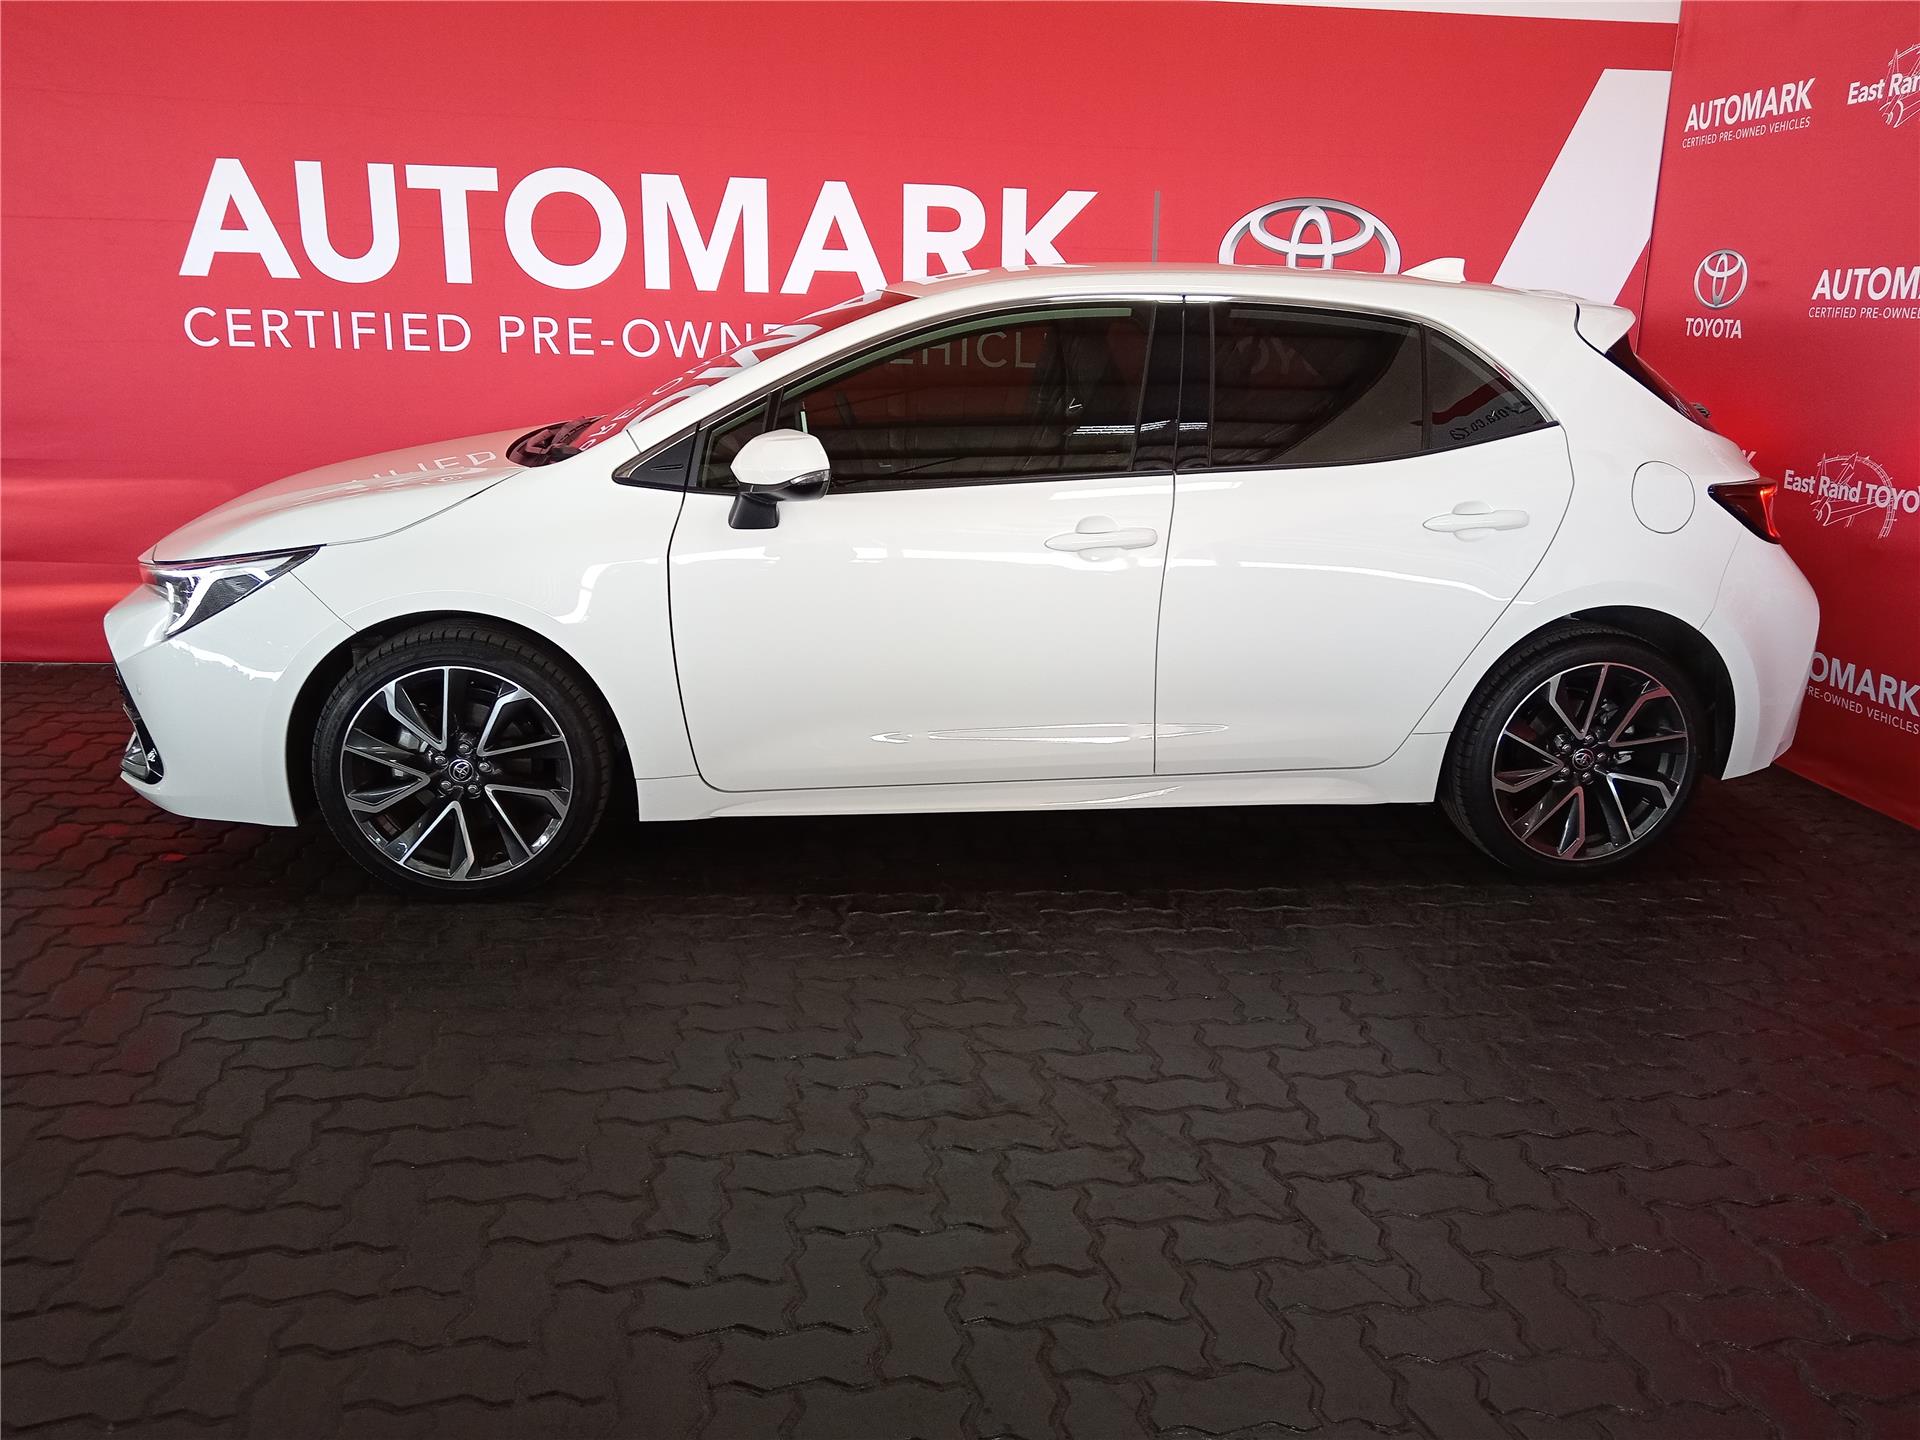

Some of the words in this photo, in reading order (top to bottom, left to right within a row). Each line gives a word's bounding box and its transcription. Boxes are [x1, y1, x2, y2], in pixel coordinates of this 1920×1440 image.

[1684, 78, 1816, 132] AUTOMARK
[1847, 79, 1886, 104] East
[1888, 73, 1920, 97] Ran
[1682, 133, 1717, 148] CERTIFIED
[1719, 124, 1767, 142] PRE-OWNED
[1769, 116, 1811, 133] VEHICLES
[178, 157, 1098, 294] AUTOMARK
[1811, 266, 1920, 300] AUTOM
[184, 306, 472, 352] CERTIFIED
[499, 315, 785, 358] PRE-OWN
[1685, 317, 1742, 338] TOYOTA
[1808, 307, 1857, 318] CERTIFIED
[1859, 307, 1920, 319] PRE-OWNE
[1783, 469, 1816, 494] East
[1818, 475, 1862, 503] Rand
[1865, 483, 1920, 514] TOYO
[1809, 651, 1920, 717] OMARK
[1804, 684, 1863, 714] RE-OWNED
[1867, 707, 1920, 735] VEHICLES
